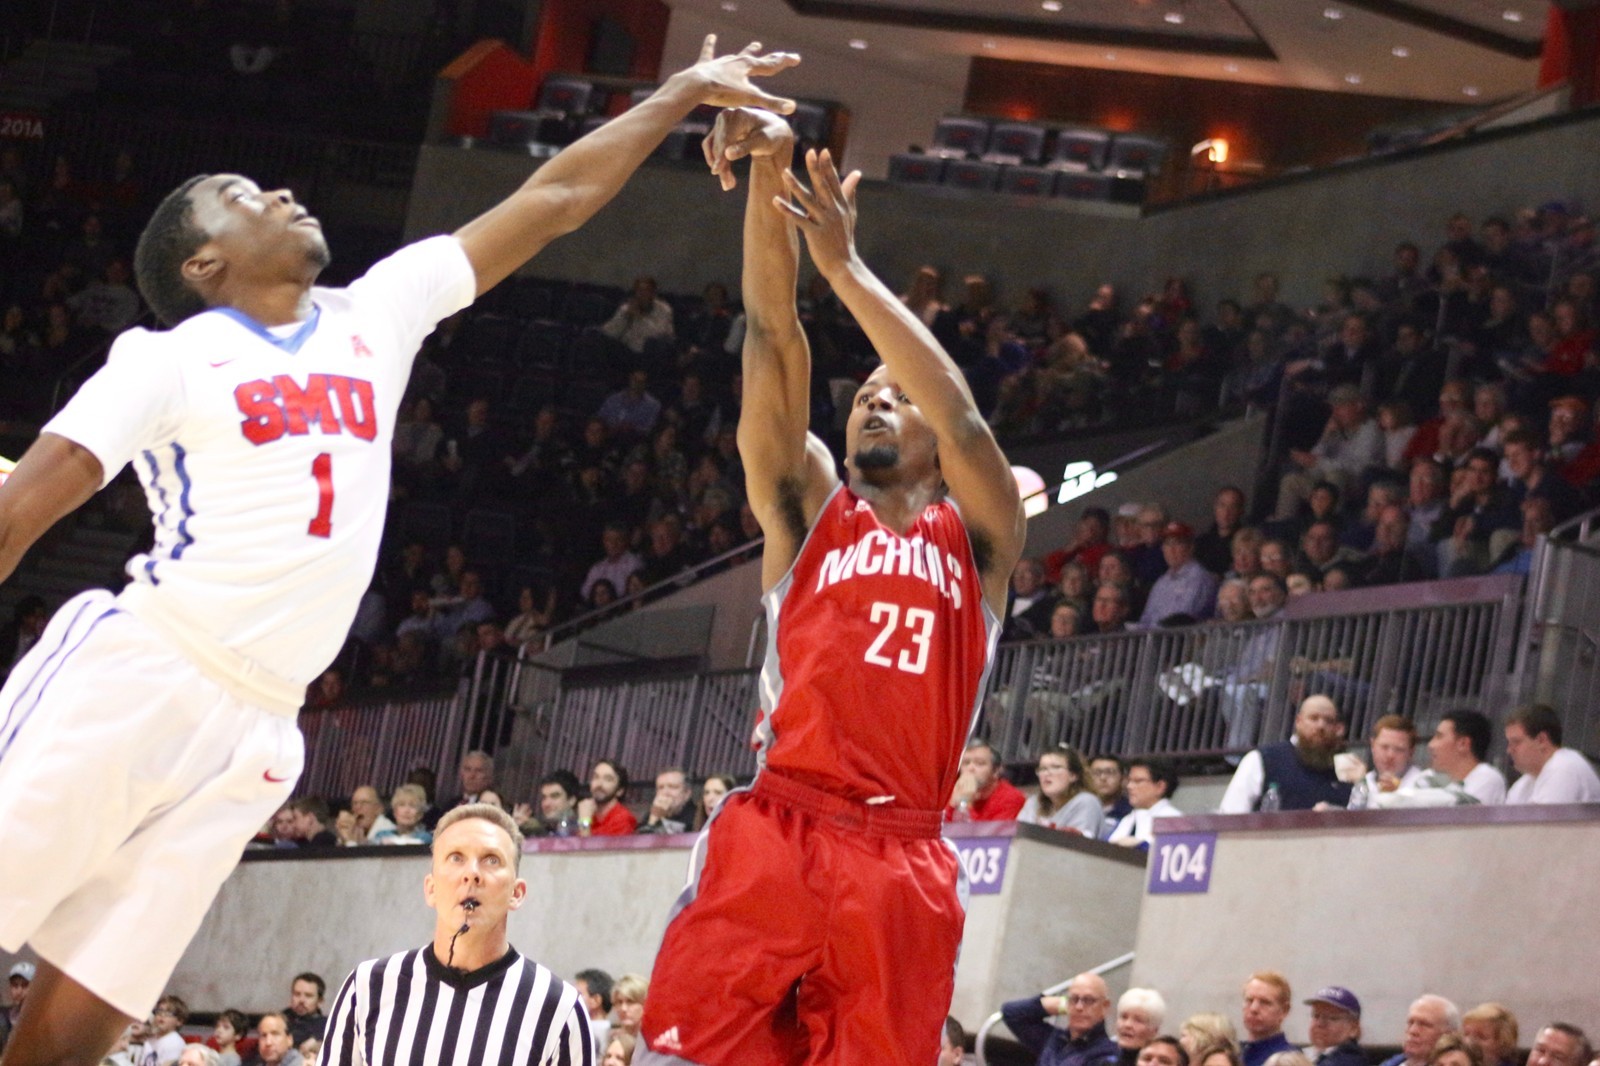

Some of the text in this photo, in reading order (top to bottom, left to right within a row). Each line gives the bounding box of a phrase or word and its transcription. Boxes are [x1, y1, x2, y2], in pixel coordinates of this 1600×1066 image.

[1, 118, 44, 138] 201A
[233, 373, 377, 446] SMU
[307, 452, 334, 538] 1
[864, 601, 935, 675] 23
[1160, 843, 1207, 883] 104
